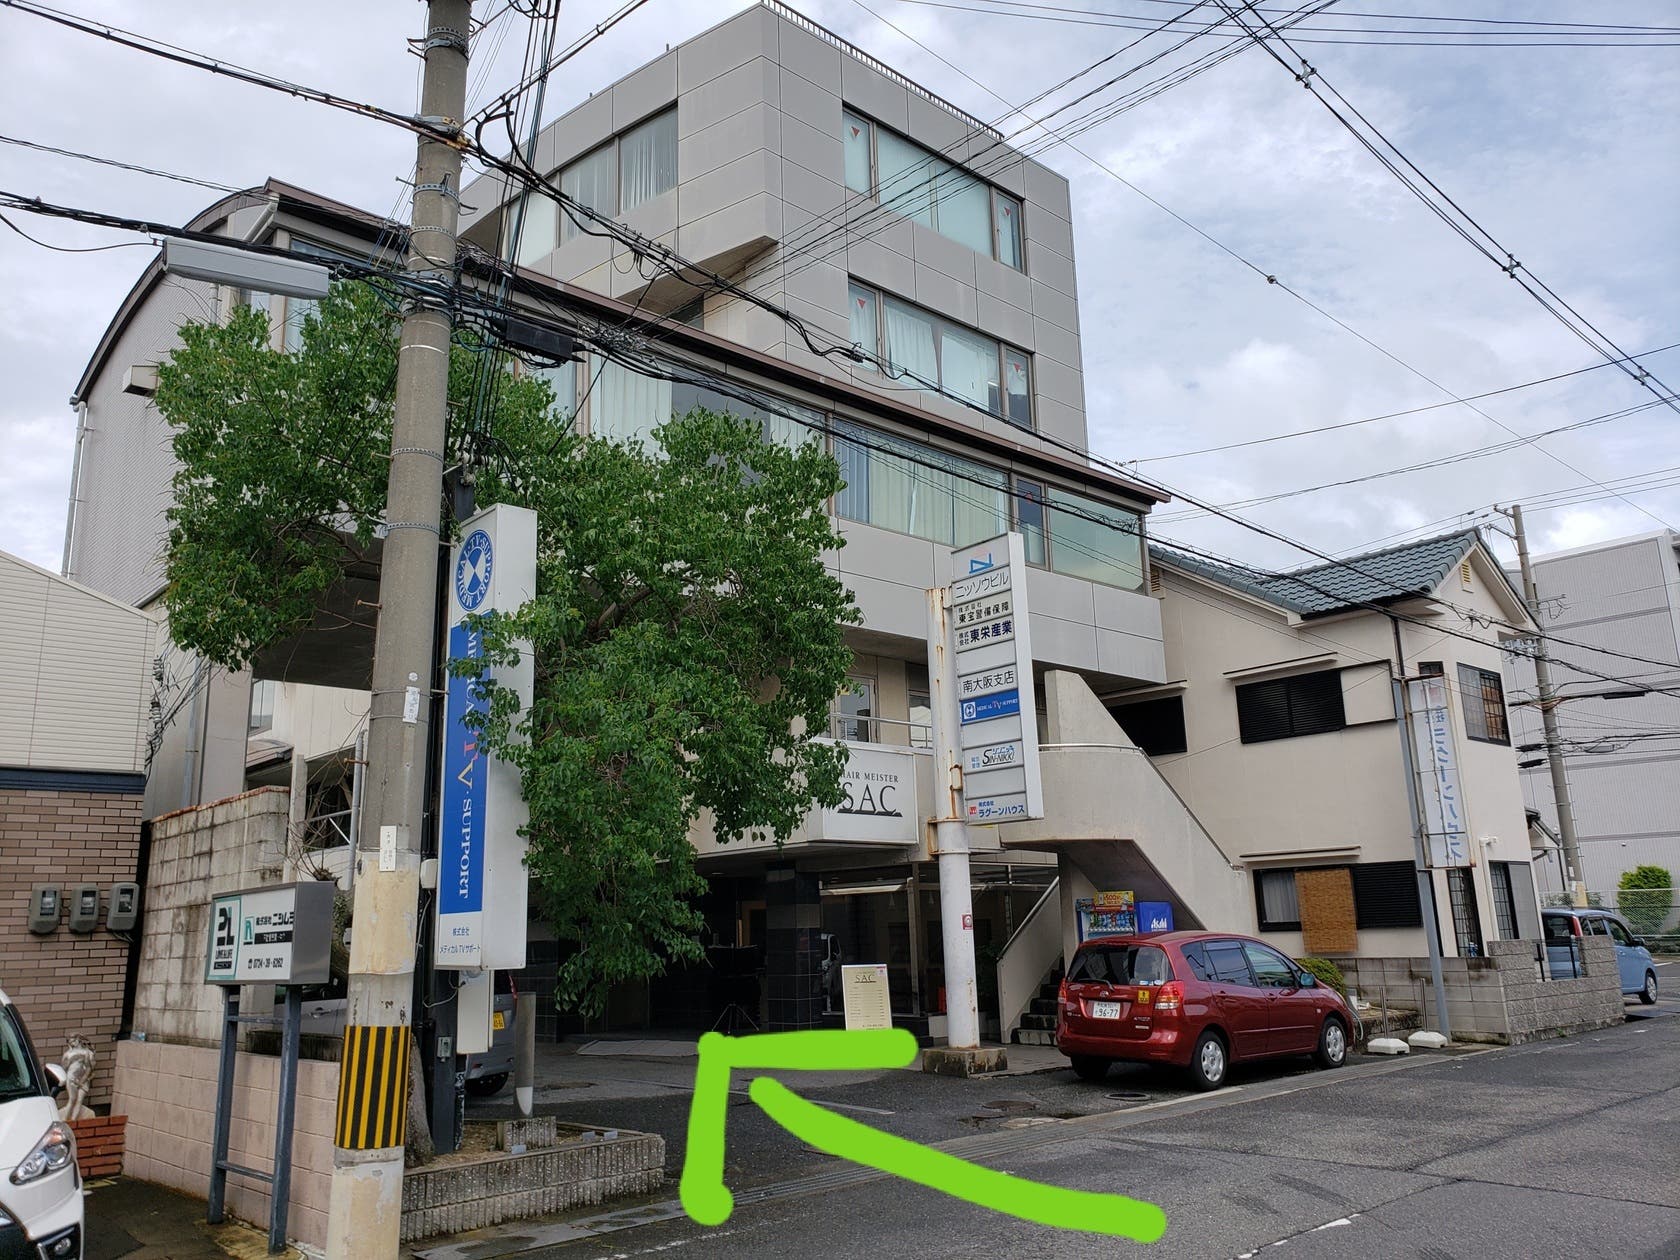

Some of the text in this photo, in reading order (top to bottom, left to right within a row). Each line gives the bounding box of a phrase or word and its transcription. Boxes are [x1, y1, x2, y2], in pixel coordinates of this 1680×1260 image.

[955, 573, 1009, 598] ニッソウビル
[970, 620, 1012, 643] 東栄産業
[962, 670, 1014, 693] 南大阪支店
[864, 773, 898, 783] MEISTER
[842, 782, 896, 812] SAC
[979, 805, 1025, 817] ラグーンハウス
[459, 798, 473, 899] SUPPORT
